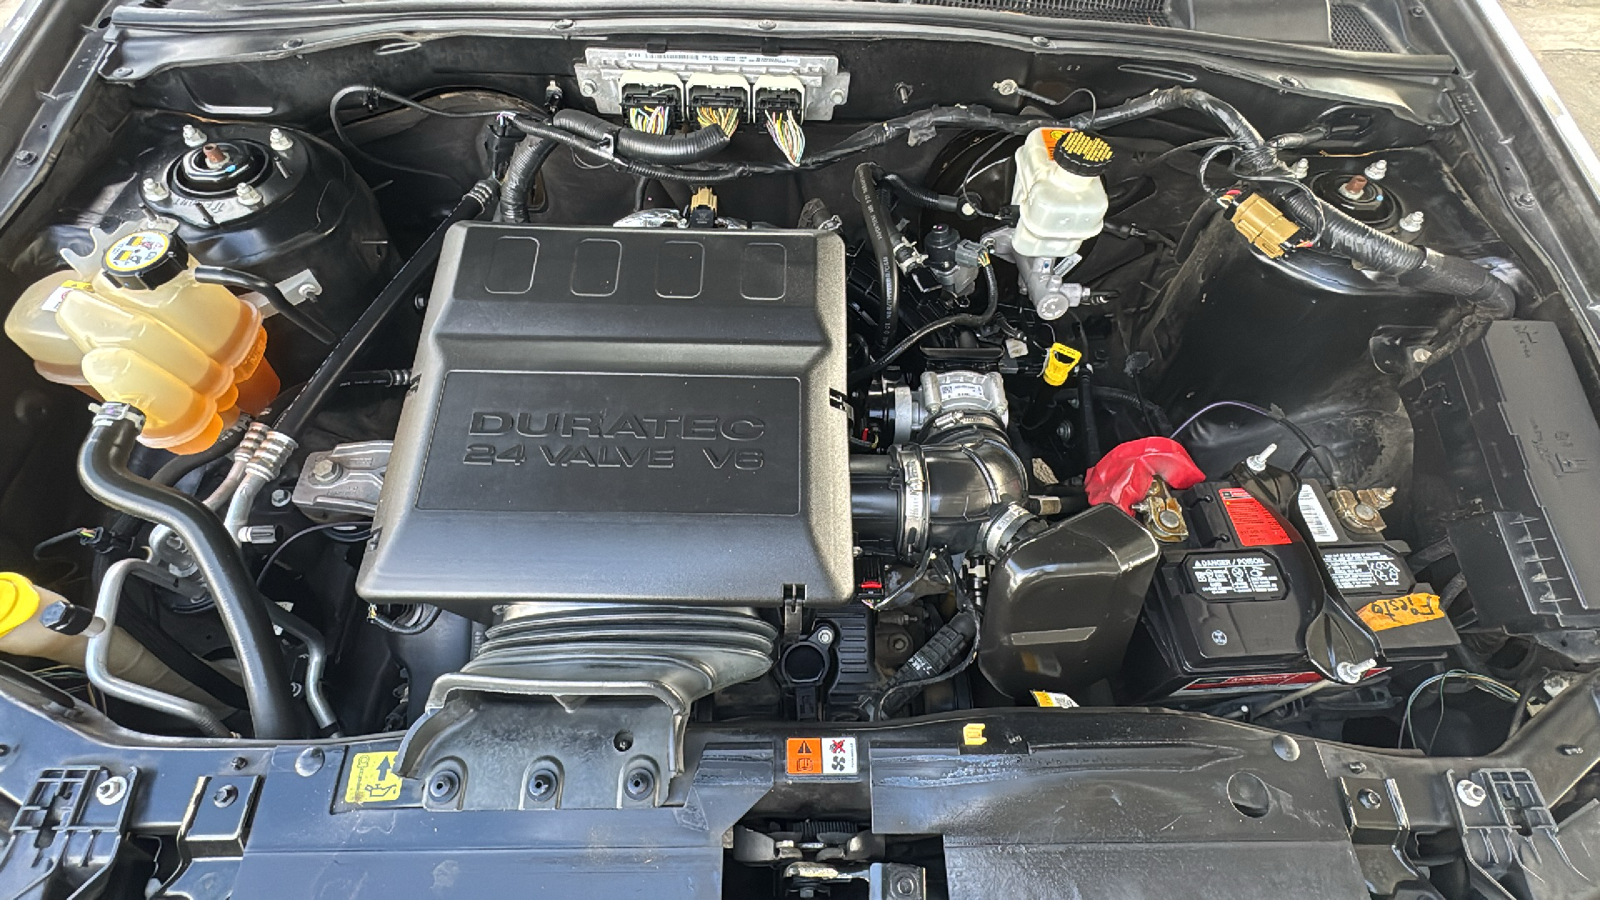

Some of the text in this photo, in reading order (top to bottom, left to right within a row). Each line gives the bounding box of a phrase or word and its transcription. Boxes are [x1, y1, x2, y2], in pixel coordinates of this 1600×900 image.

[468, 411, 765, 441] DURATEC
[463, 443, 764, 470] 24 VALVE V6
[1201, 559, 1231, 567] DANGER
